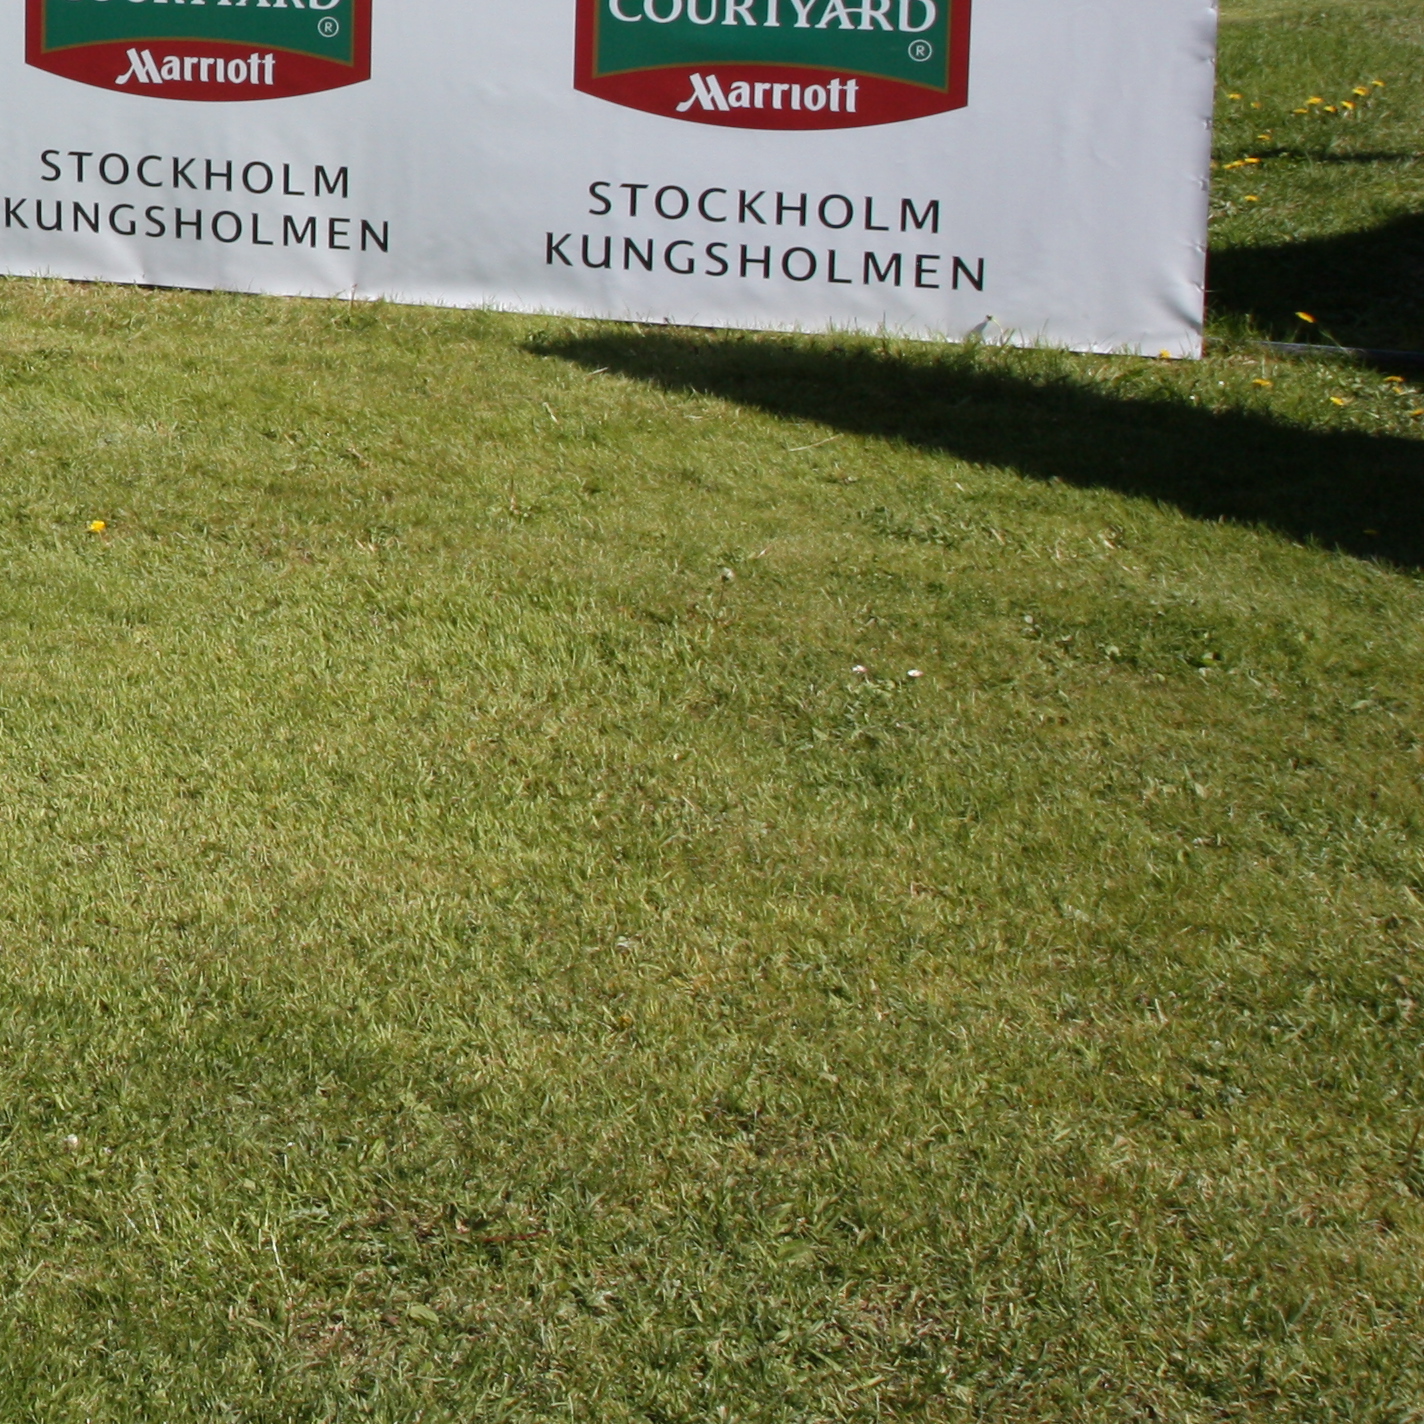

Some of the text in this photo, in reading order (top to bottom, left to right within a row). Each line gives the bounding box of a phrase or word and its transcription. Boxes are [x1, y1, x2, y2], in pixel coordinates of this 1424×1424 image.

[115, 48, 276, 86] Marriott
[675, 72, 859, 113] Marriott
[40, 149, 350, 199] STOCKHOLM
[3, 197, 390, 254] KUNGSHOLMEN
[588, 180, 941, 234] STOCKHOLM
[544, 231, 986, 293] KUNGSHOLMEN
